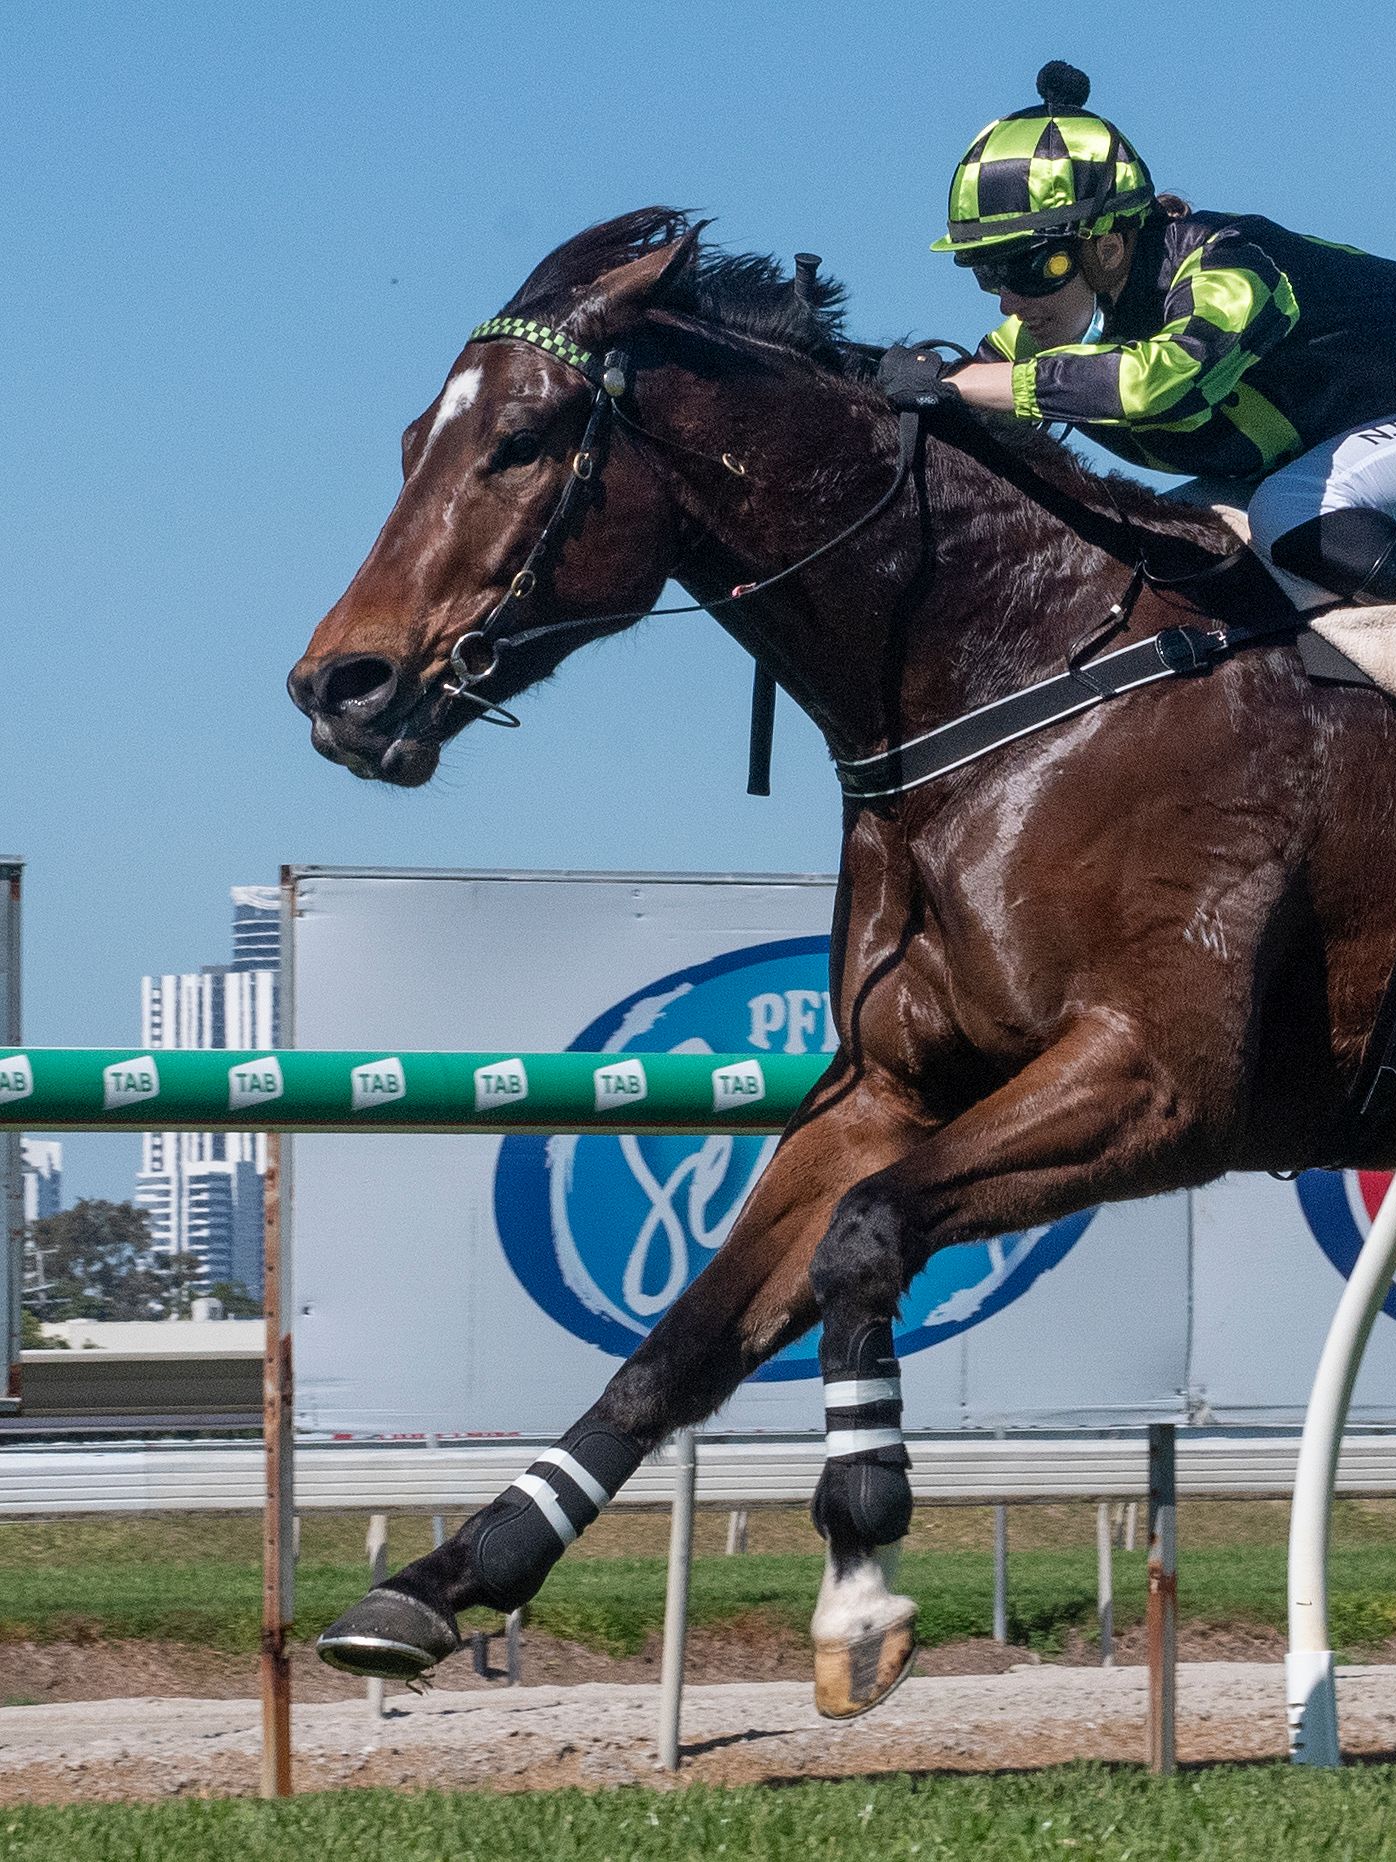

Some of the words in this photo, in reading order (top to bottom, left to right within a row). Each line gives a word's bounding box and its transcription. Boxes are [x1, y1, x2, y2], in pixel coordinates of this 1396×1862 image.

[0, 1071, 25, 1092] AB
[110, 1071, 152, 1093] TAB
[235, 1072, 276, 1093] TAB
[358, 1073, 400, 1094] TAB
[481, 1074, 522, 1095] TAB
[600, 1074, 641, 1095] TAB
[719, 1075, 759, 1095] TAB
